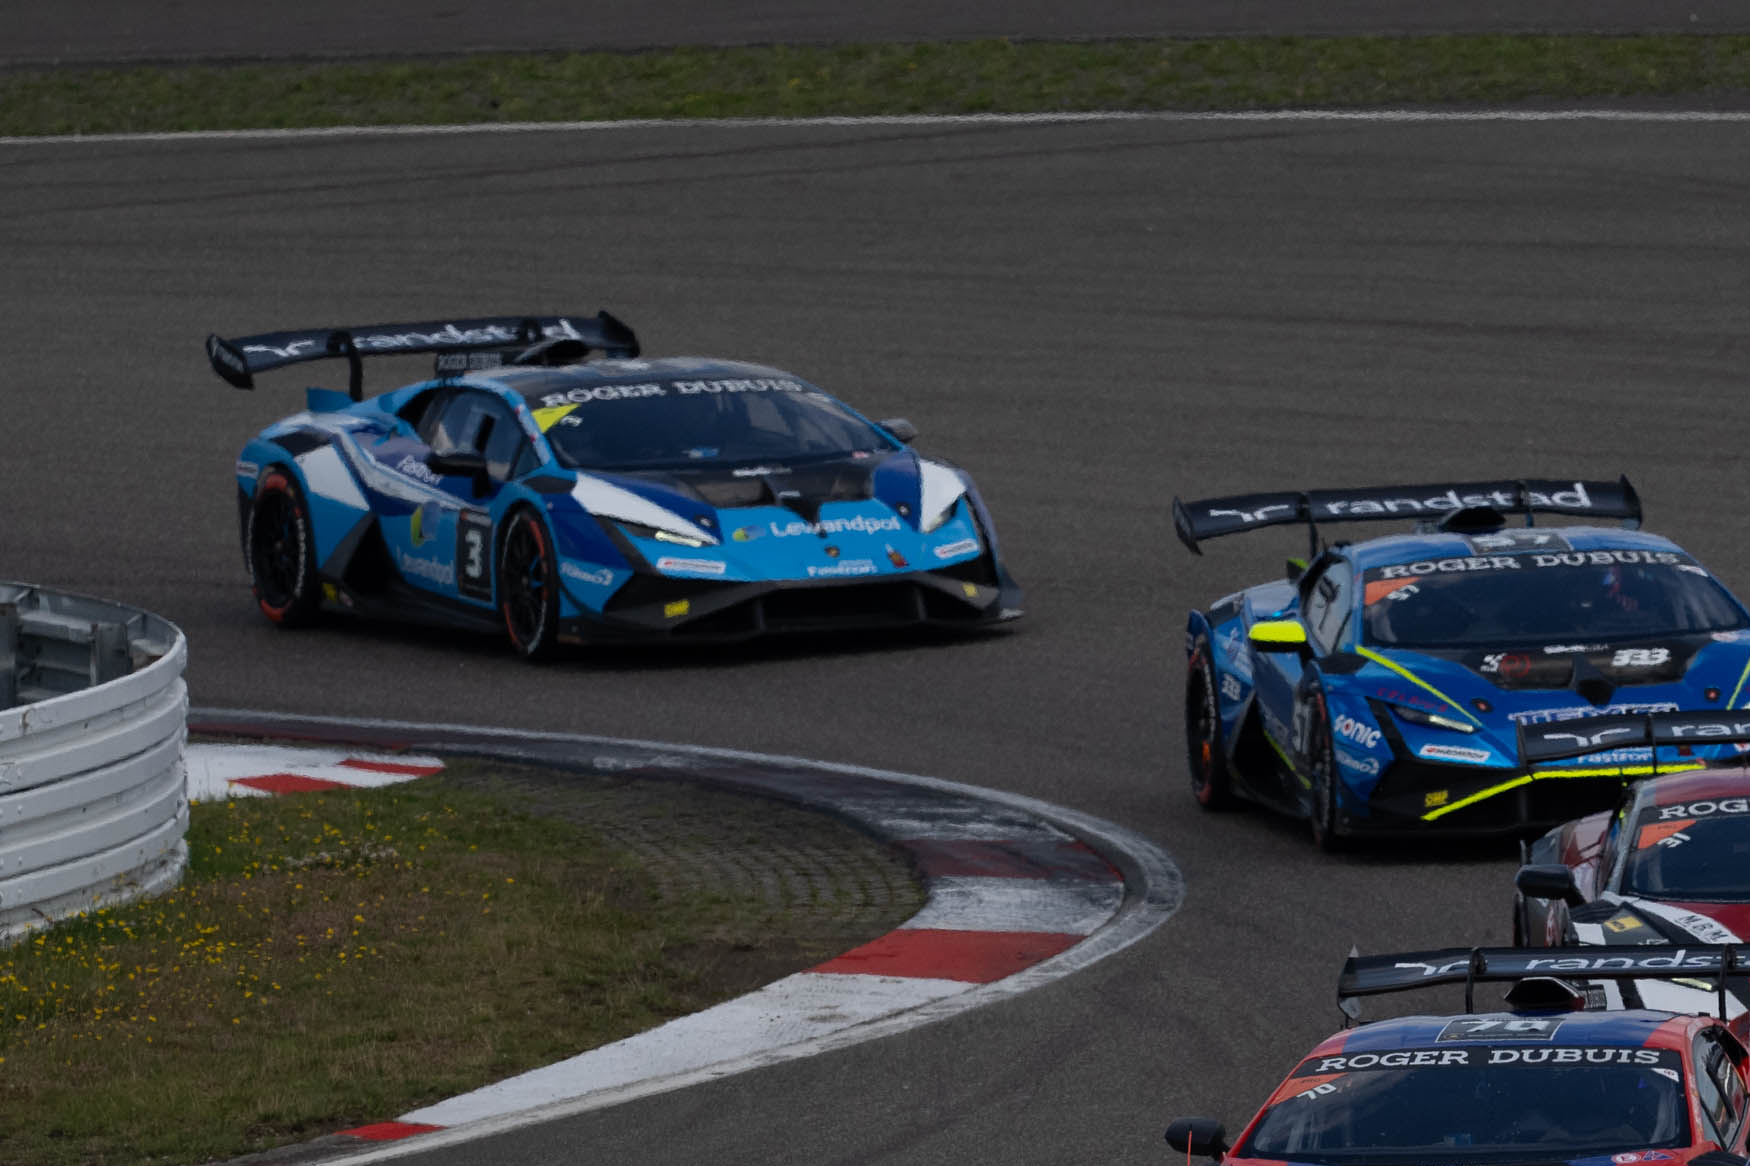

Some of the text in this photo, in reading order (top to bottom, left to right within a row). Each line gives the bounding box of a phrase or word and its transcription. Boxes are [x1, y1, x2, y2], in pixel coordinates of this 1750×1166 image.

[464, 529, 484, 578] 3
[1380, 551, 1681, 579] ROGER DUBUIS
[1315, 1048, 1661, 1072] ROGER DUBUIS
[1297, 1083, 1337, 1101] 70
